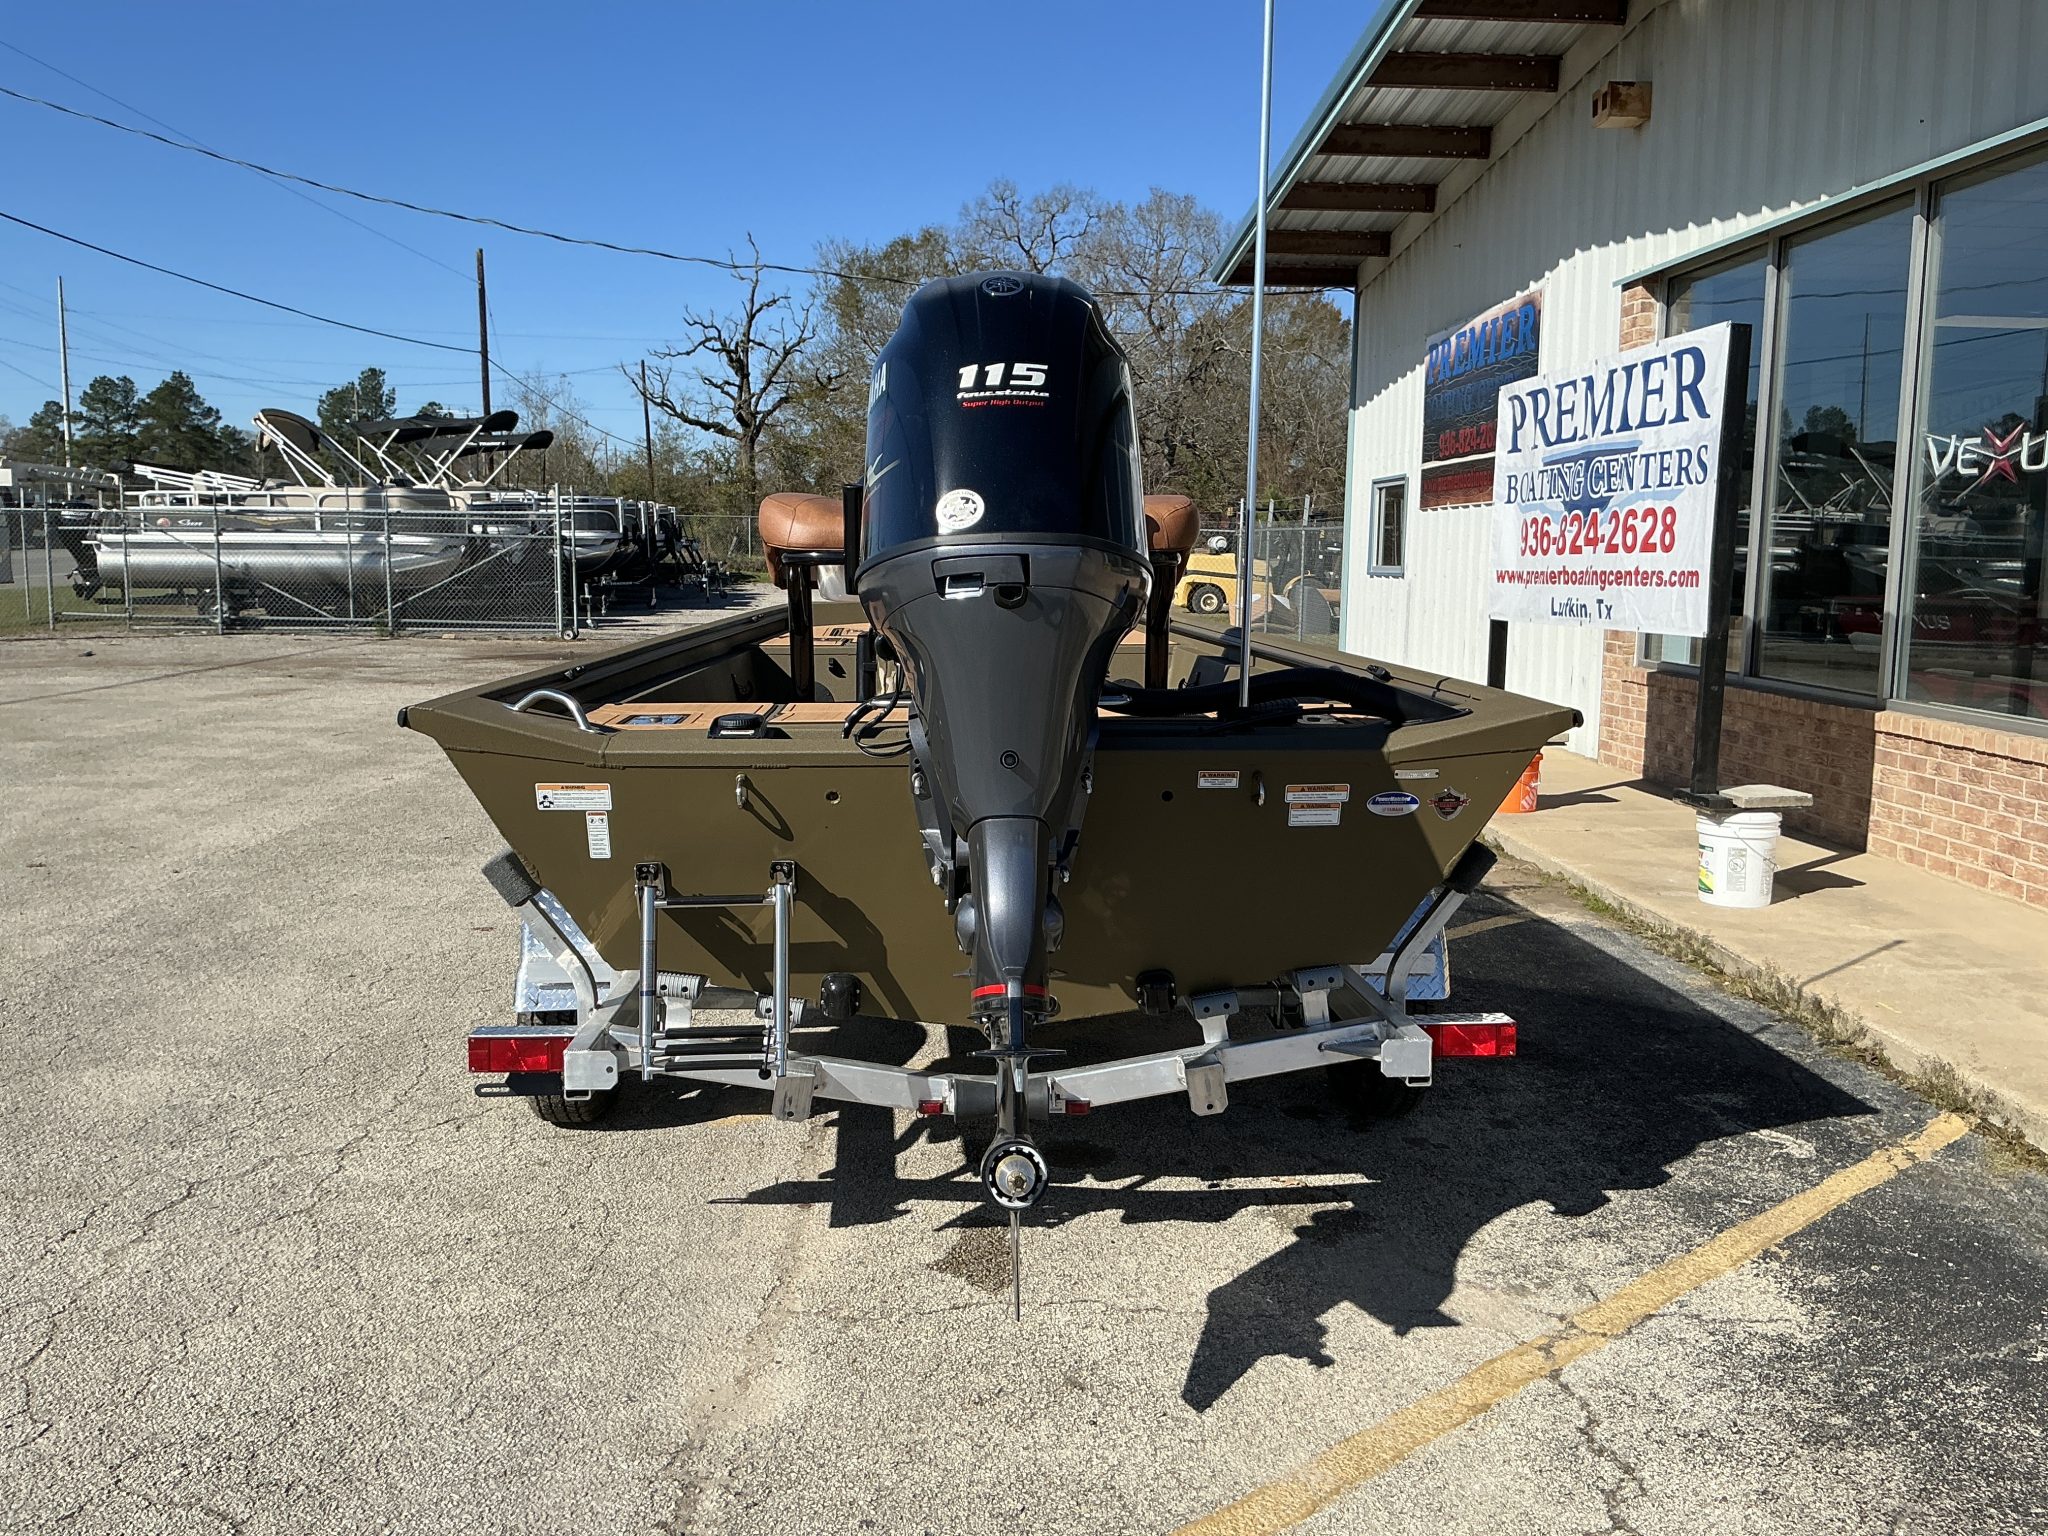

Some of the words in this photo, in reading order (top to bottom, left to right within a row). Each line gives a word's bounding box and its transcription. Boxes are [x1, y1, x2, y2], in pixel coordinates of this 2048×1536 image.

[1427, 304, 1536, 385] PREMIER
[958, 362, 1048, 389] 115
[1507, 346, 1710, 454] PREMIER
[1504, 461, 1585, 504] BOATING
[1589, 444, 1709, 498] CENTERS
[1520, 505, 1677, 557] 936-824-2628
[1496, 565, 1700, 591] www.premierboatingcenters.com
[1550, 597, 1592, 623] Lufkin,
[1596, 598, 1613, 620] Tx
